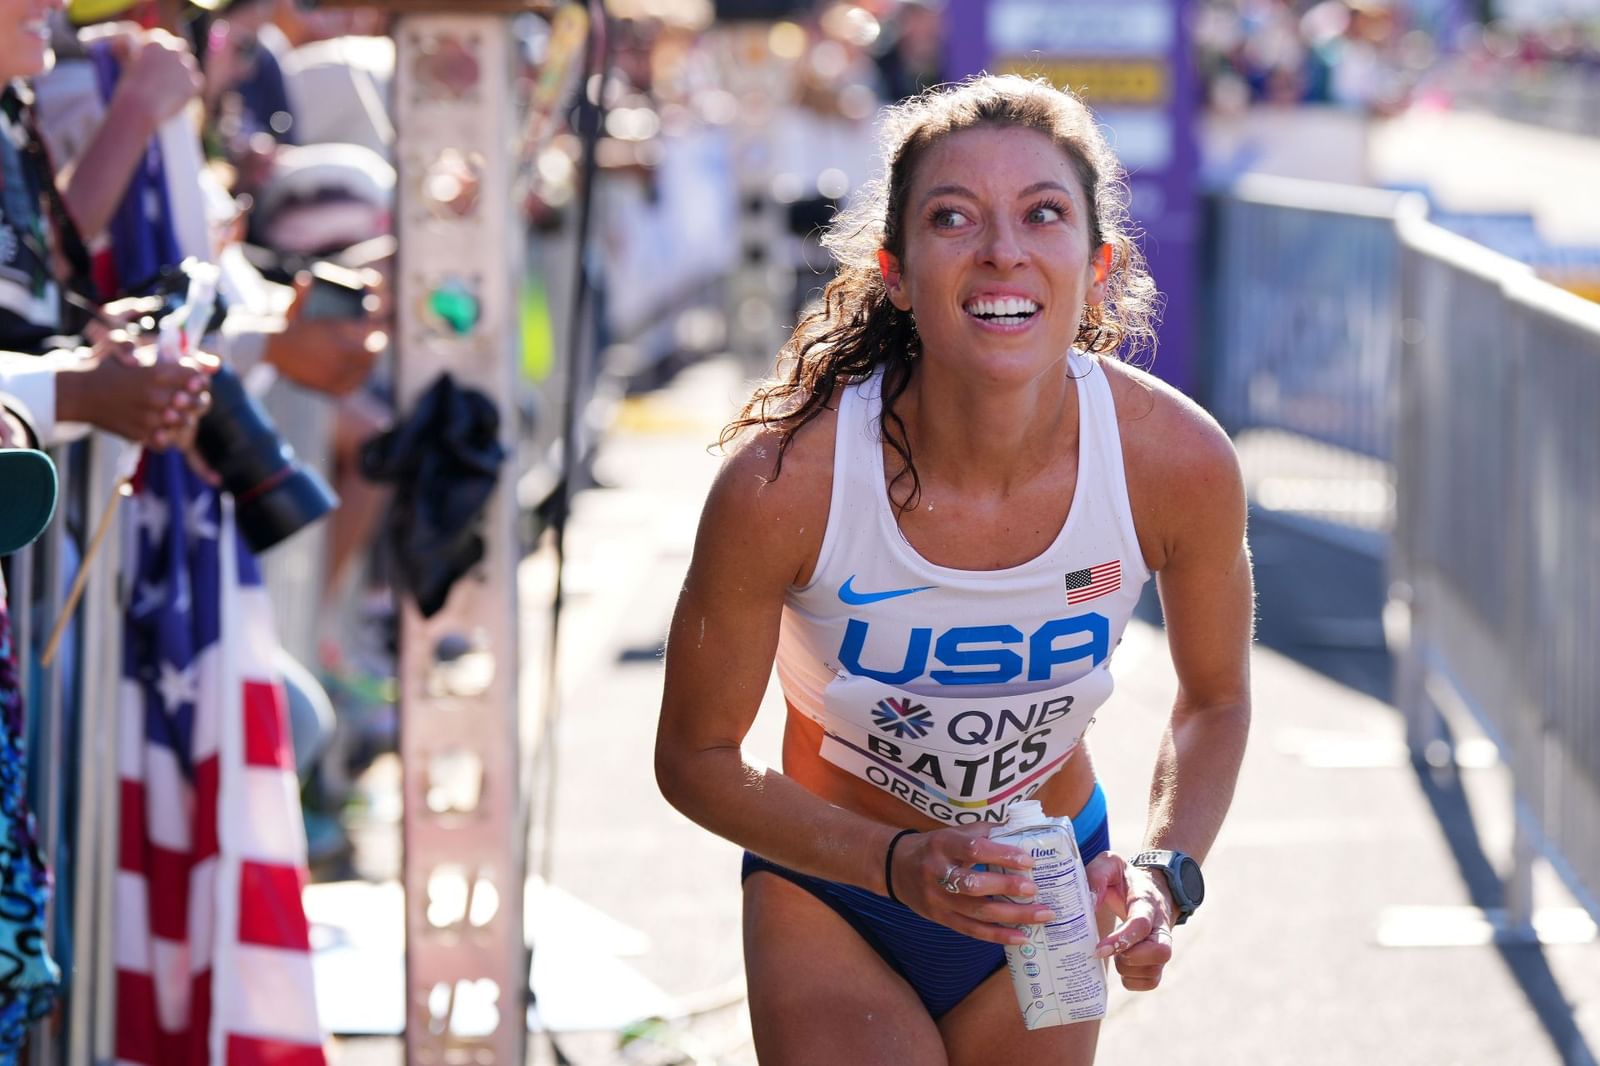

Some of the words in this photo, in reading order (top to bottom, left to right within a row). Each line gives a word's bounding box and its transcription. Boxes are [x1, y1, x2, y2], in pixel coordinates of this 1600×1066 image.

[838, 612, 1110, 686] USA
[947, 695, 1075, 746] QNB
[867, 728, 1052, 797] BATES
[1031, 847, 1056, 857] flow
